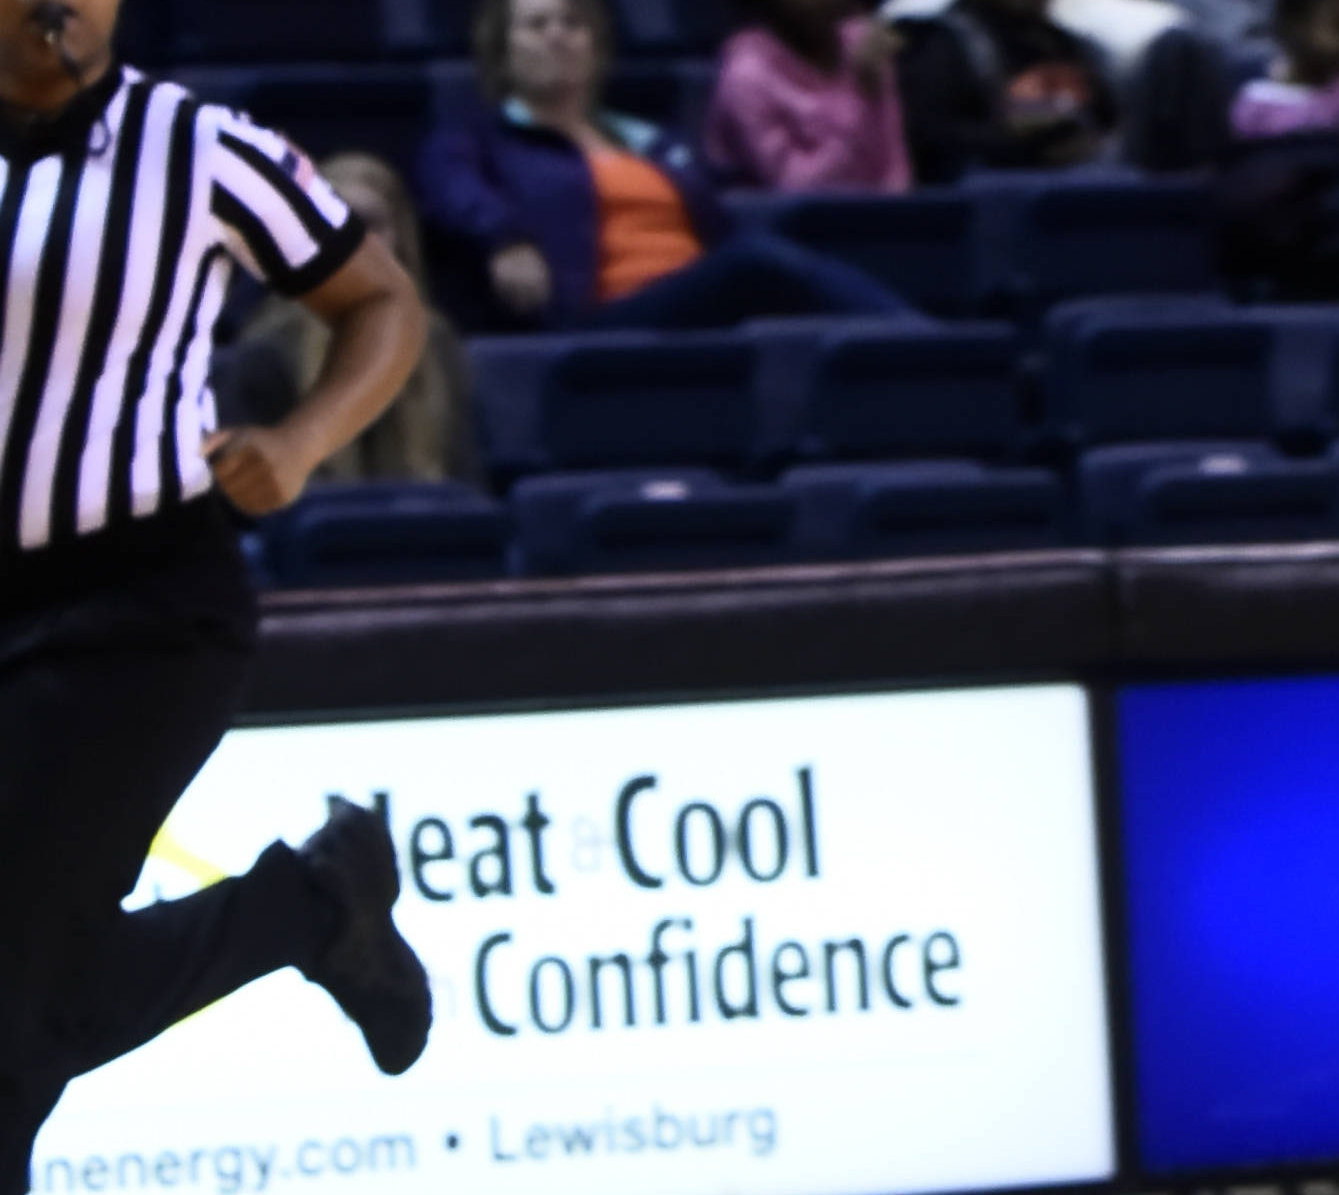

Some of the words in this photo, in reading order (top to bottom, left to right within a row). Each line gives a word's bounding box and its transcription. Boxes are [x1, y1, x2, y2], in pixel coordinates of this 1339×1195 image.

[326, 791, 554, 901] eat
[613, 763, 822, 890] Cool
[473, 914, 964, 1037] Confidence
[488, 1103, 778, 1158] Lewisburg
